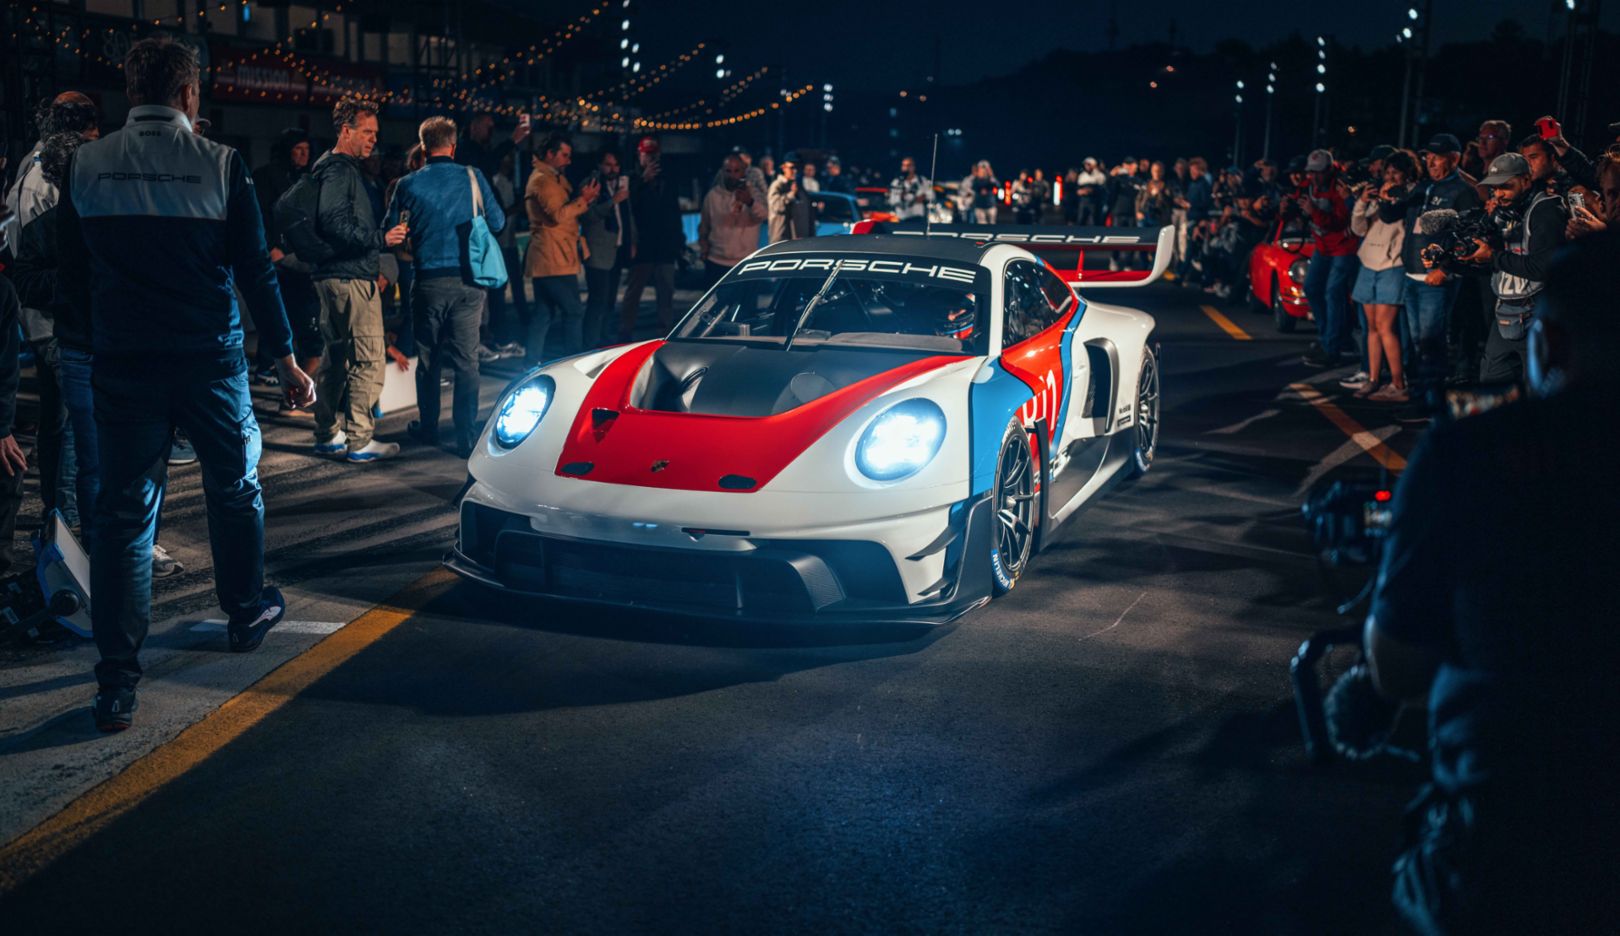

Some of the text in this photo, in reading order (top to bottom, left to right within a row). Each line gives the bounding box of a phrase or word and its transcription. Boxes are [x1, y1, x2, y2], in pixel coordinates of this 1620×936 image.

[98, 172, 201, 184] PORSCHE
[892, 231, 1140, 243] RSCHE
[737, 259, 977, 284] PORSCHE
